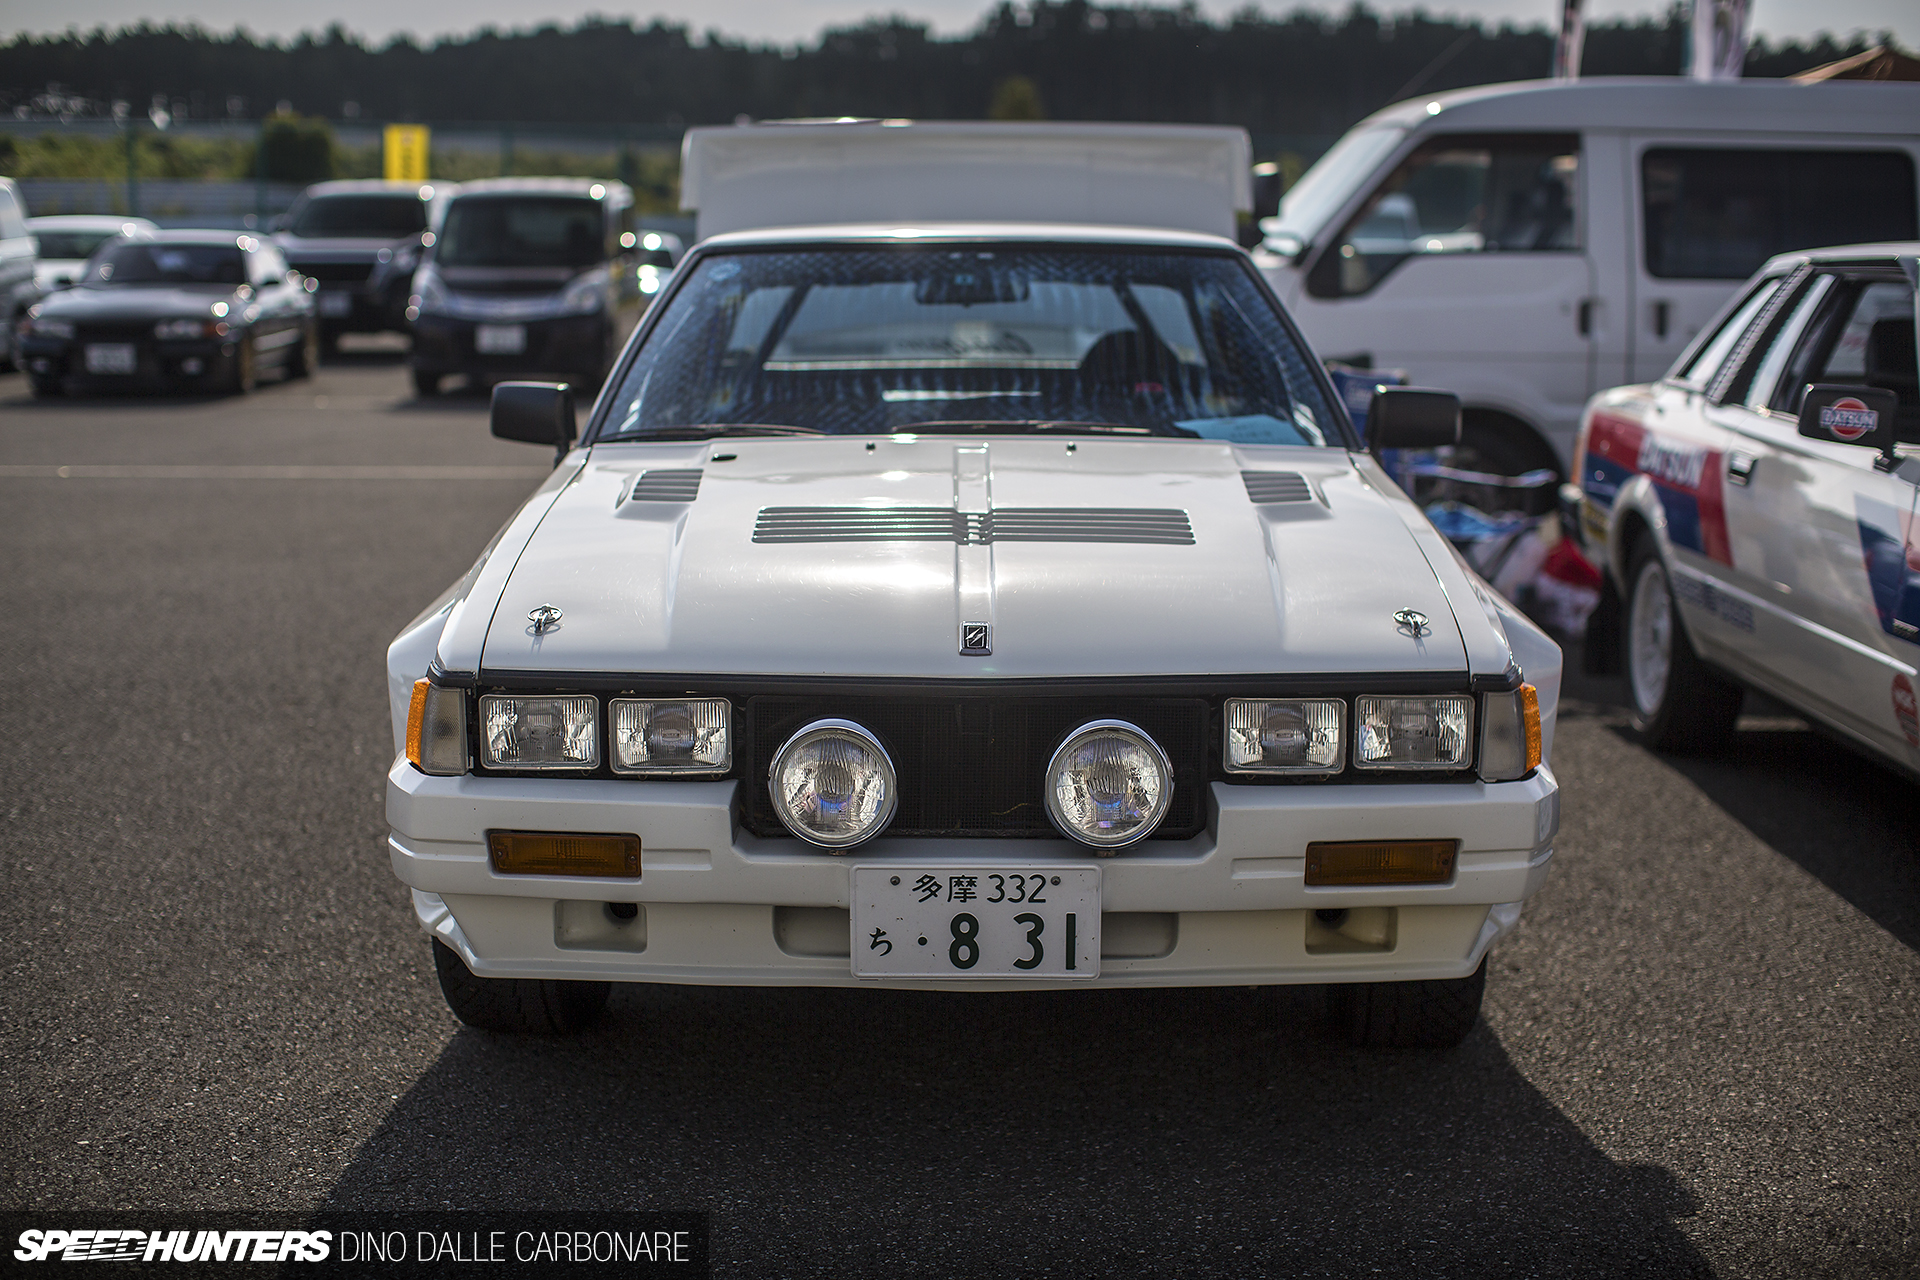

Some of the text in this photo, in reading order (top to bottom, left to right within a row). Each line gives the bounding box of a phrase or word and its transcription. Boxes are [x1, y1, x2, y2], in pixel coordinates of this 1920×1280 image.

[1821, 408, 1877, 428] DATSUN
[912, 874, 1047, 903] 多摩 332
[869, 927, 893, 957] ち
